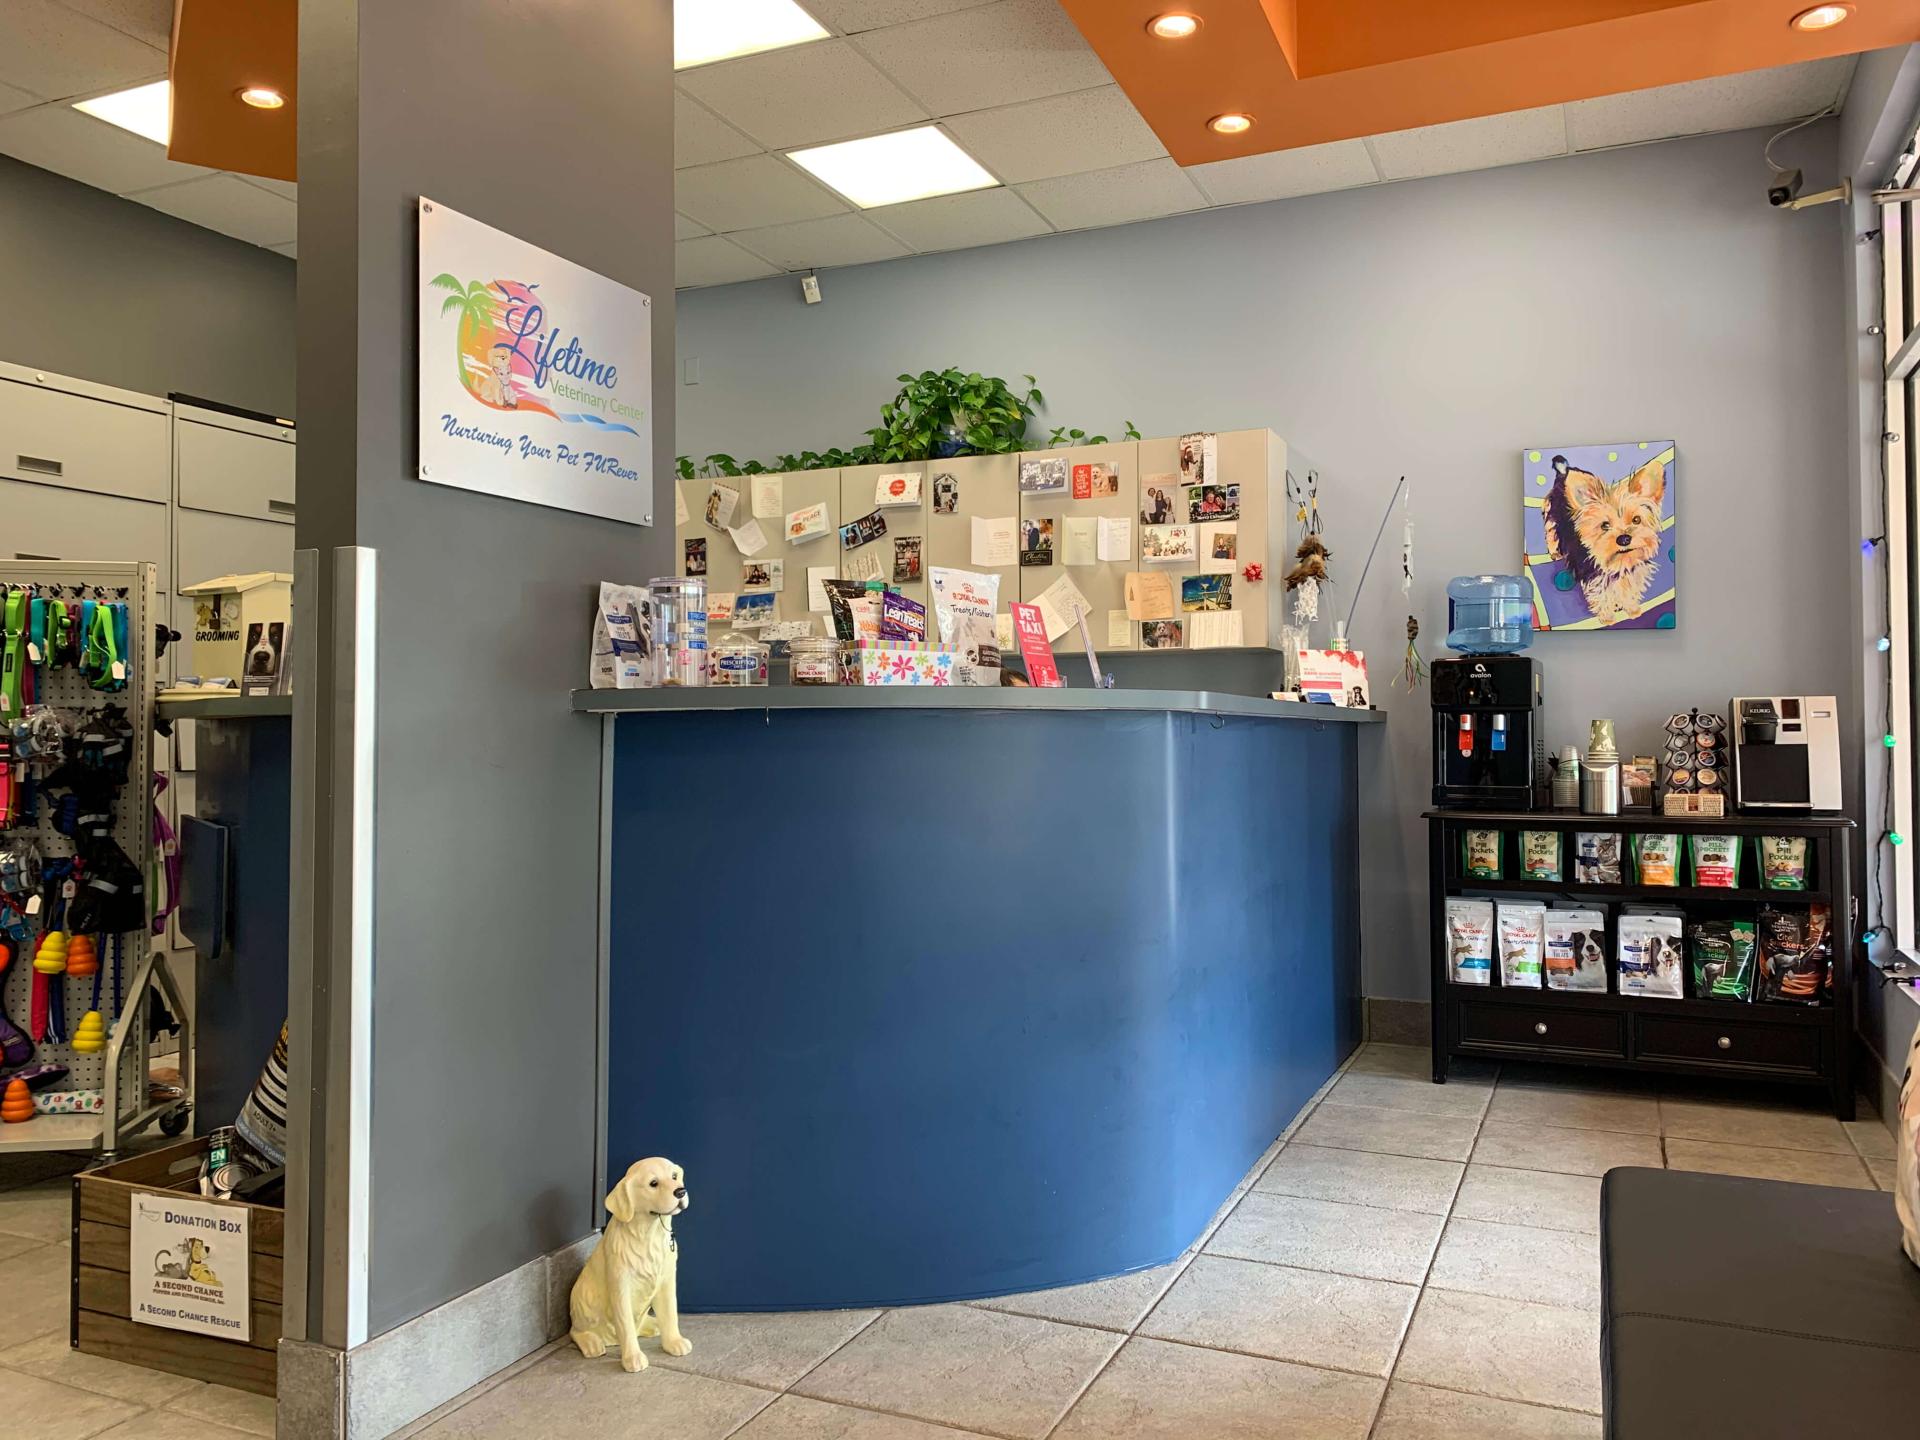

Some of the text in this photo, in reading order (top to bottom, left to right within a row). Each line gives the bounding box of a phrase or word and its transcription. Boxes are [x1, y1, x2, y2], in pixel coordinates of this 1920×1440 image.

[494, 305, 618, 389] Lifetime
[551, 377, 645, 421] Veterinary Center
[441, 414, 639, 481] Nurturing Your Pet FURever
[1018, 607, 1036, 620] PET
[196, 630, 240, 642] GROOMING
[1019, 620, 1043, 635] TAXI
[1768, 853, 1800, 861] Pockets
[1777, 933, 1793, 941] Lite
[253, 1110, 269, 1128] ADULT
[211, 1149, 226, 1161] EN
[164, 1211, 217, 1230] DONATION
[219, 1219, 242, 1233] BOX
[154, 1280, 224, 1299] A SECOND CHANCE
[139, 1303, 241, 1329] A SECOND CHANCE RESCUE
